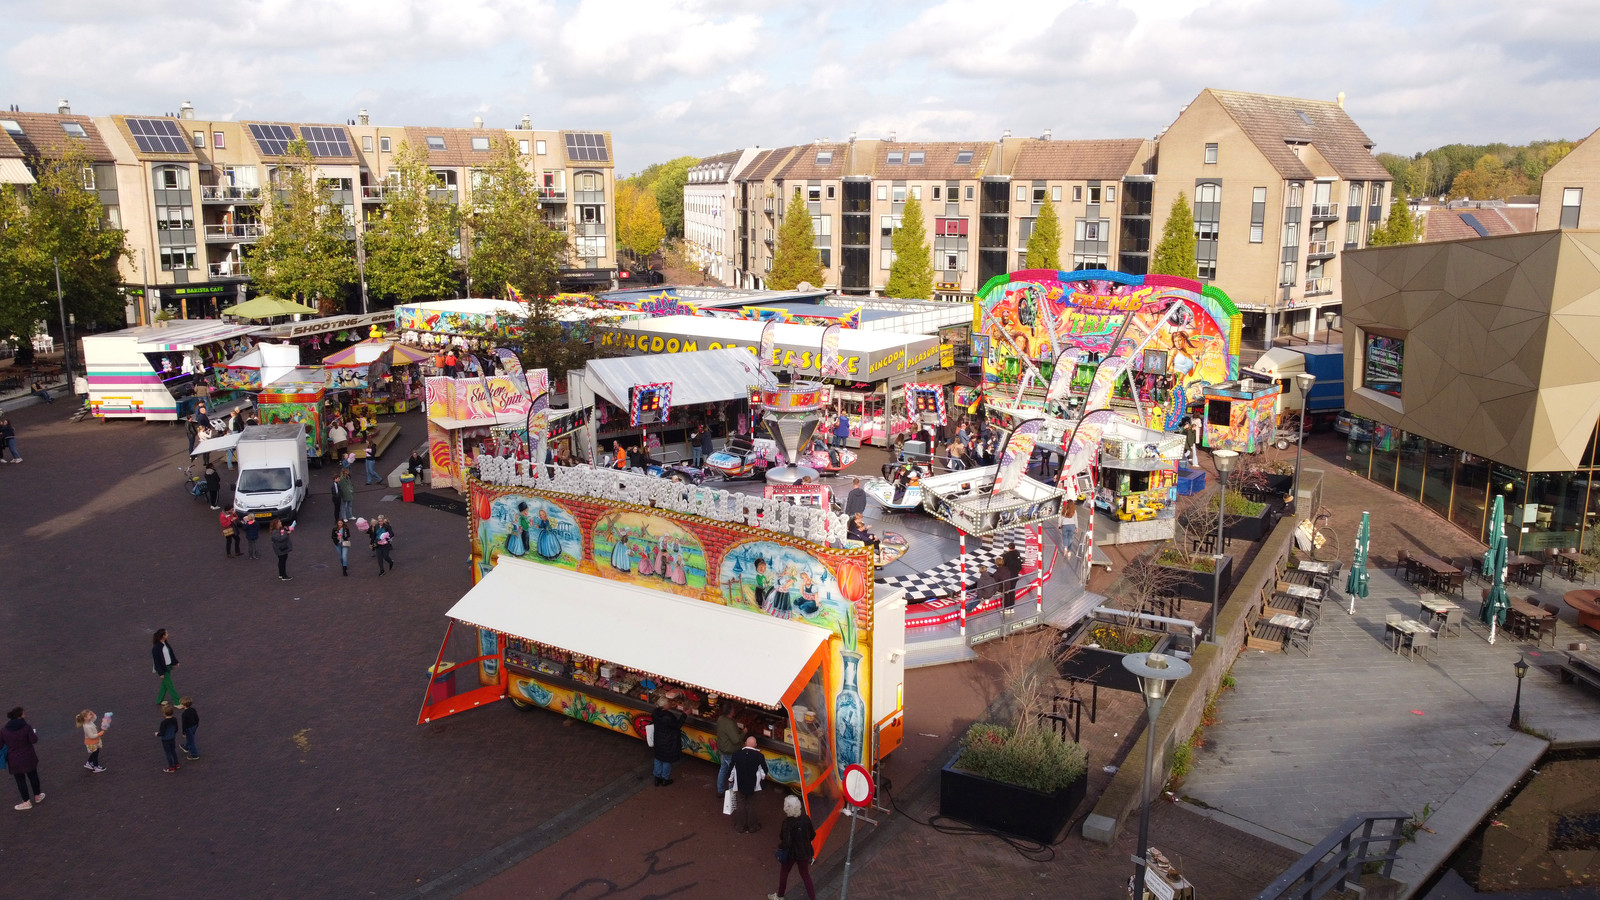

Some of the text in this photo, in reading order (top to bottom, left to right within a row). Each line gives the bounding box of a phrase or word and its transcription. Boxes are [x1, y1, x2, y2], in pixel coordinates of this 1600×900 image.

[1047, 285, 1154, 311] EXTREME
[293, 317, 359, 335] SHOOTING
[1070, 312, 1126, 335] TRIP
[601, 331, 699, 354] KINGDOM
[869, 348, 905, 374] KINGDOM
[896, 361, 905, 371] OF
[907, 344, 939, 369] PLEASURE
